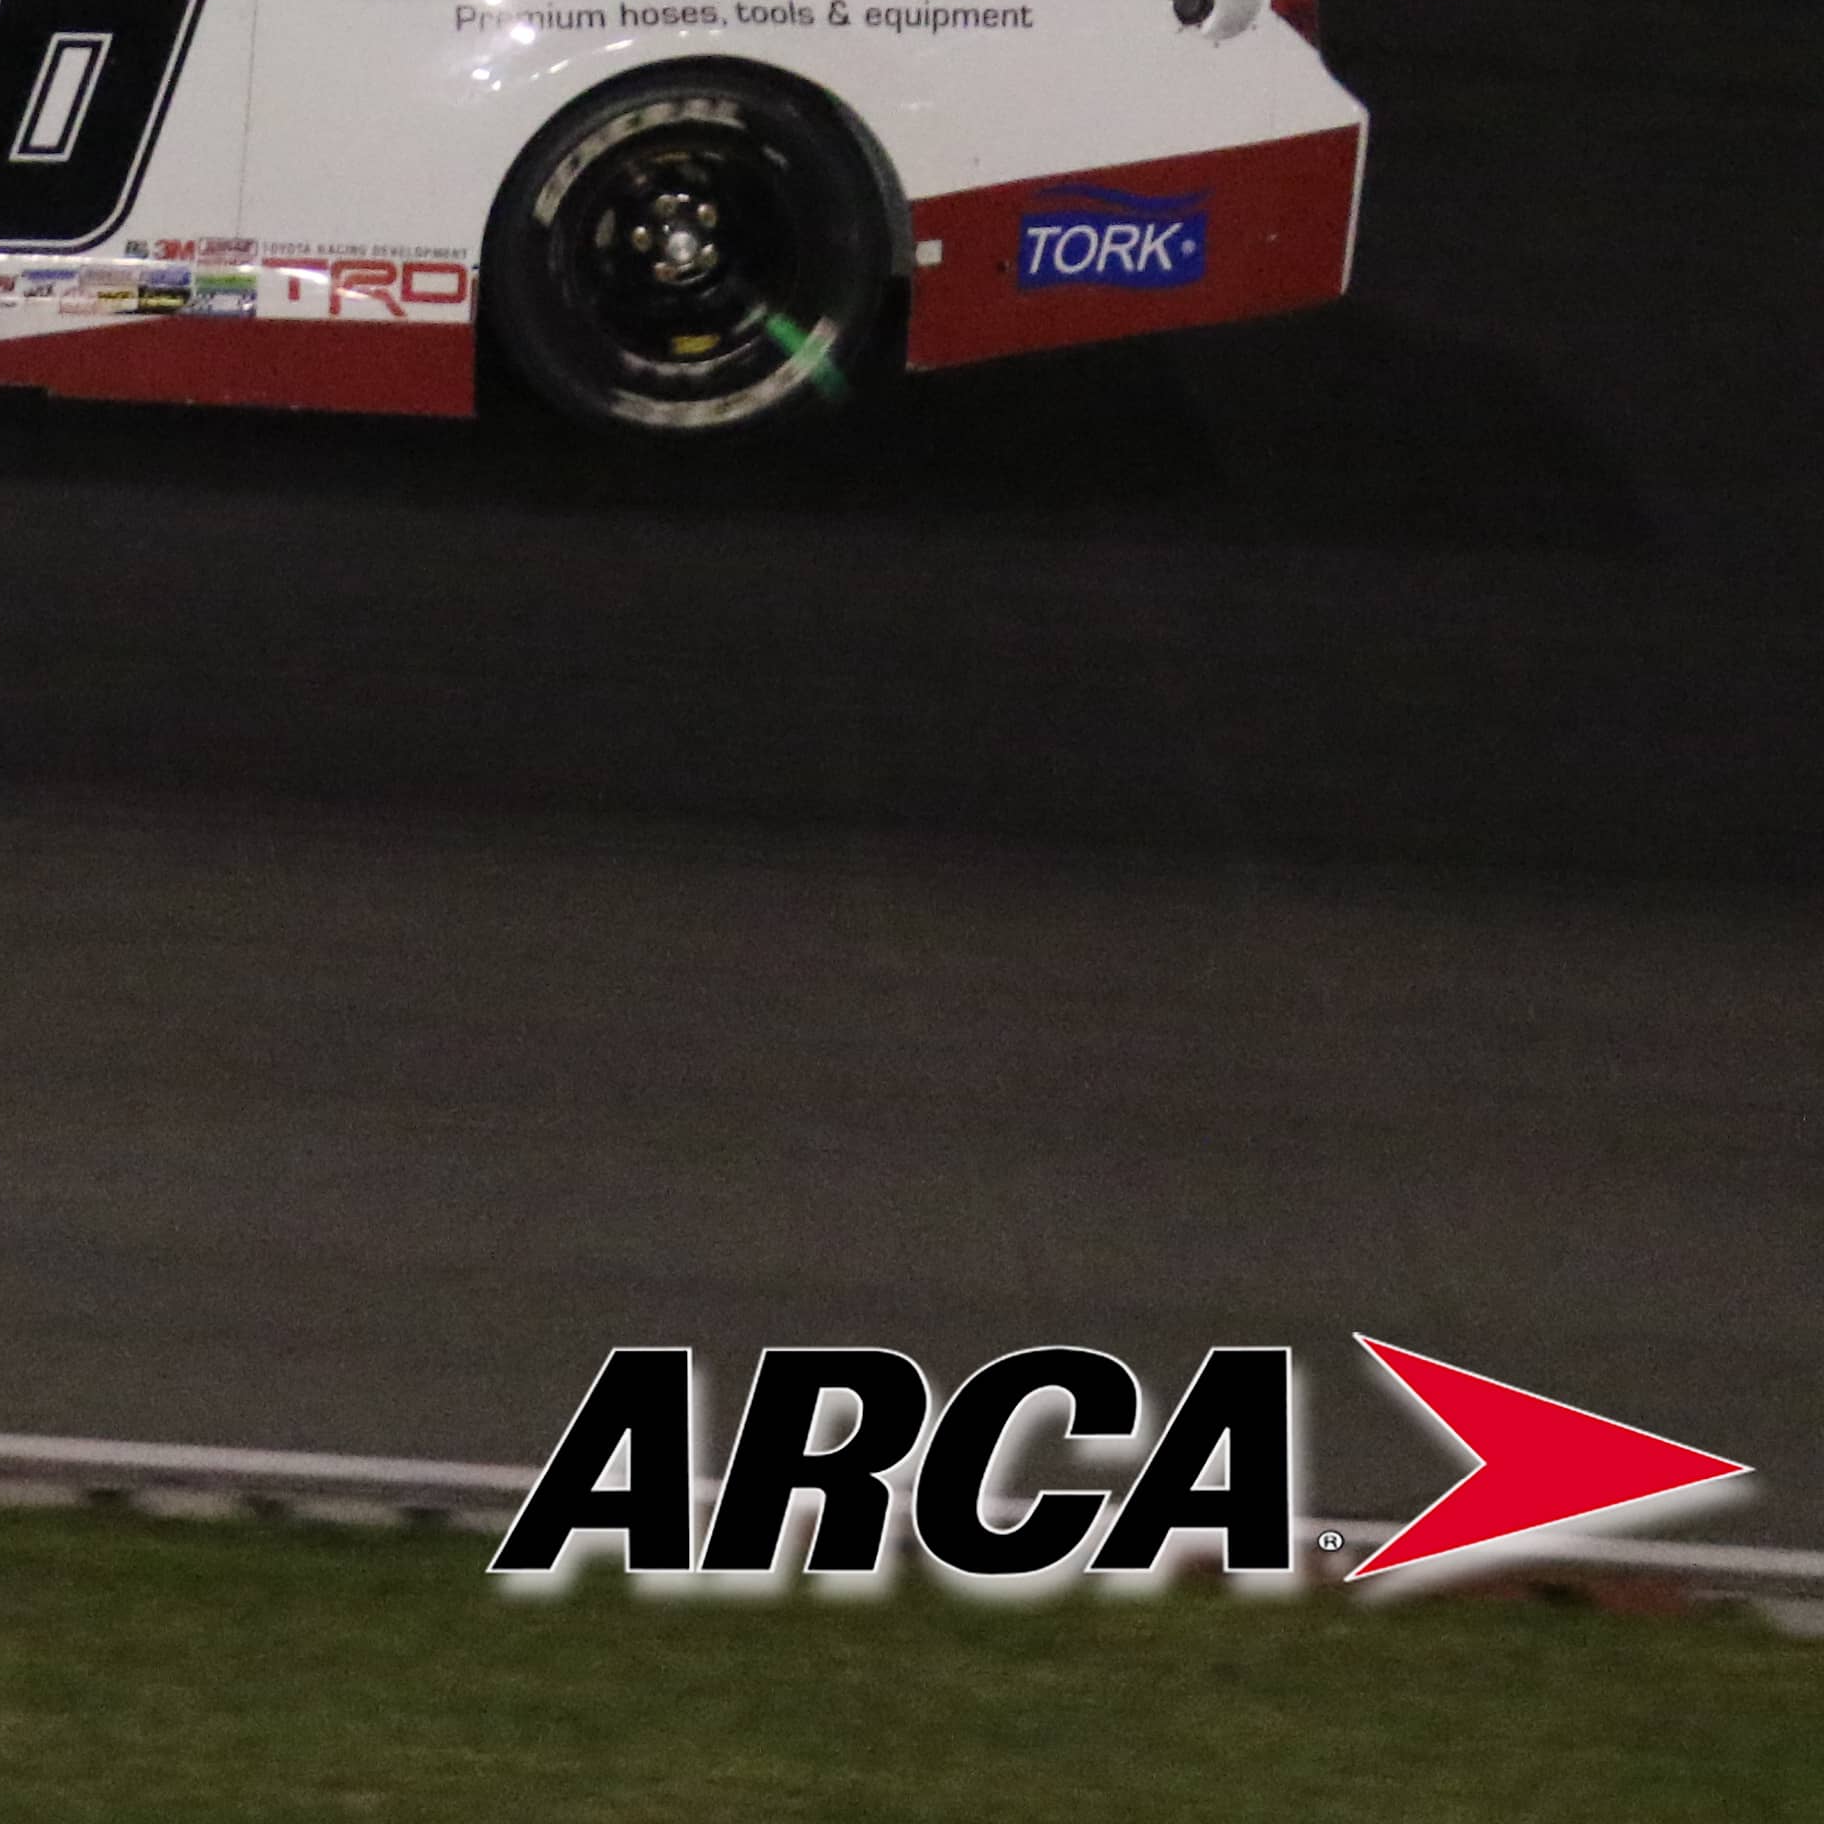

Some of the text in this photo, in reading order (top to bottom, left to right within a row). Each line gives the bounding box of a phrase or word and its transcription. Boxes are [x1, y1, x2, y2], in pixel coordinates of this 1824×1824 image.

[620, 3, 728, 28] hoses,
[735, 0, 814, 25] tools
[827, 1, 850, 26] &
[865, 0, 1034, 34] equipment
[154, 239, 196, 260] 3M
[1026, 222, 1184, 275] TORK
[261, 258, 469, 317] TRD
